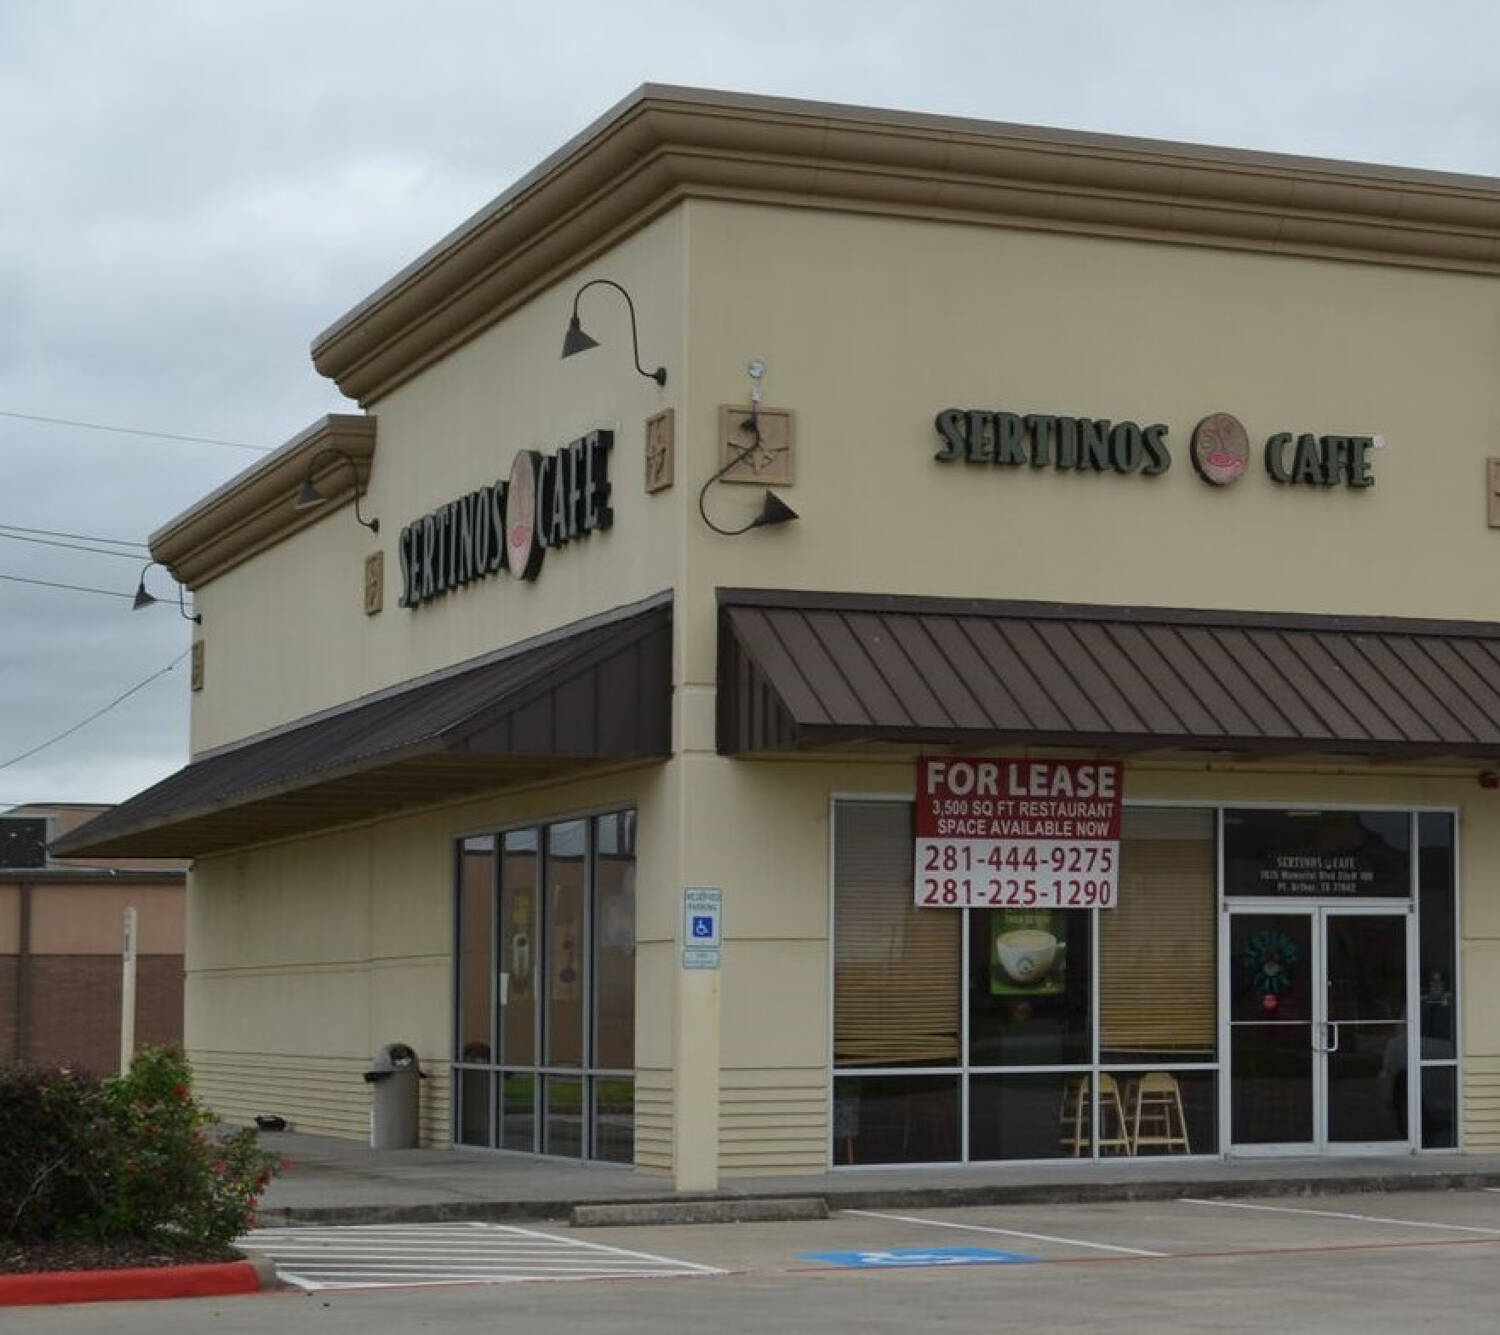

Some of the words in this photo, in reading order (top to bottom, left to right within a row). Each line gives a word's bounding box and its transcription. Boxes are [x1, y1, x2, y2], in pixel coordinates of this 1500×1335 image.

[934, 408, 1171, 475] SERTINOS
[1263, 432, 1375, 488] CAFE
[399, 480, 510, 608] SERTINOS
[537, 429, 614, 548] CAFE
[927, 762, 999, 796] FOR
[1009, 764, 1116, 798] LEASE
[932, 801, 968, 817] 3,500
[972, 802, 993, 818] SQ
[997, 802, 1014, 817] FT
[1019, 802, 1114, 819] RESTAURANT
[938, 819, 986, 835] SPACE
[990, 819, 1072, 837] AVAILABLE
[1076, 821, 1110, 837] NOW
[924, 845, 1113, 873] 281-444-9275
[924, 879, 1111, 906] 281-225-1290
